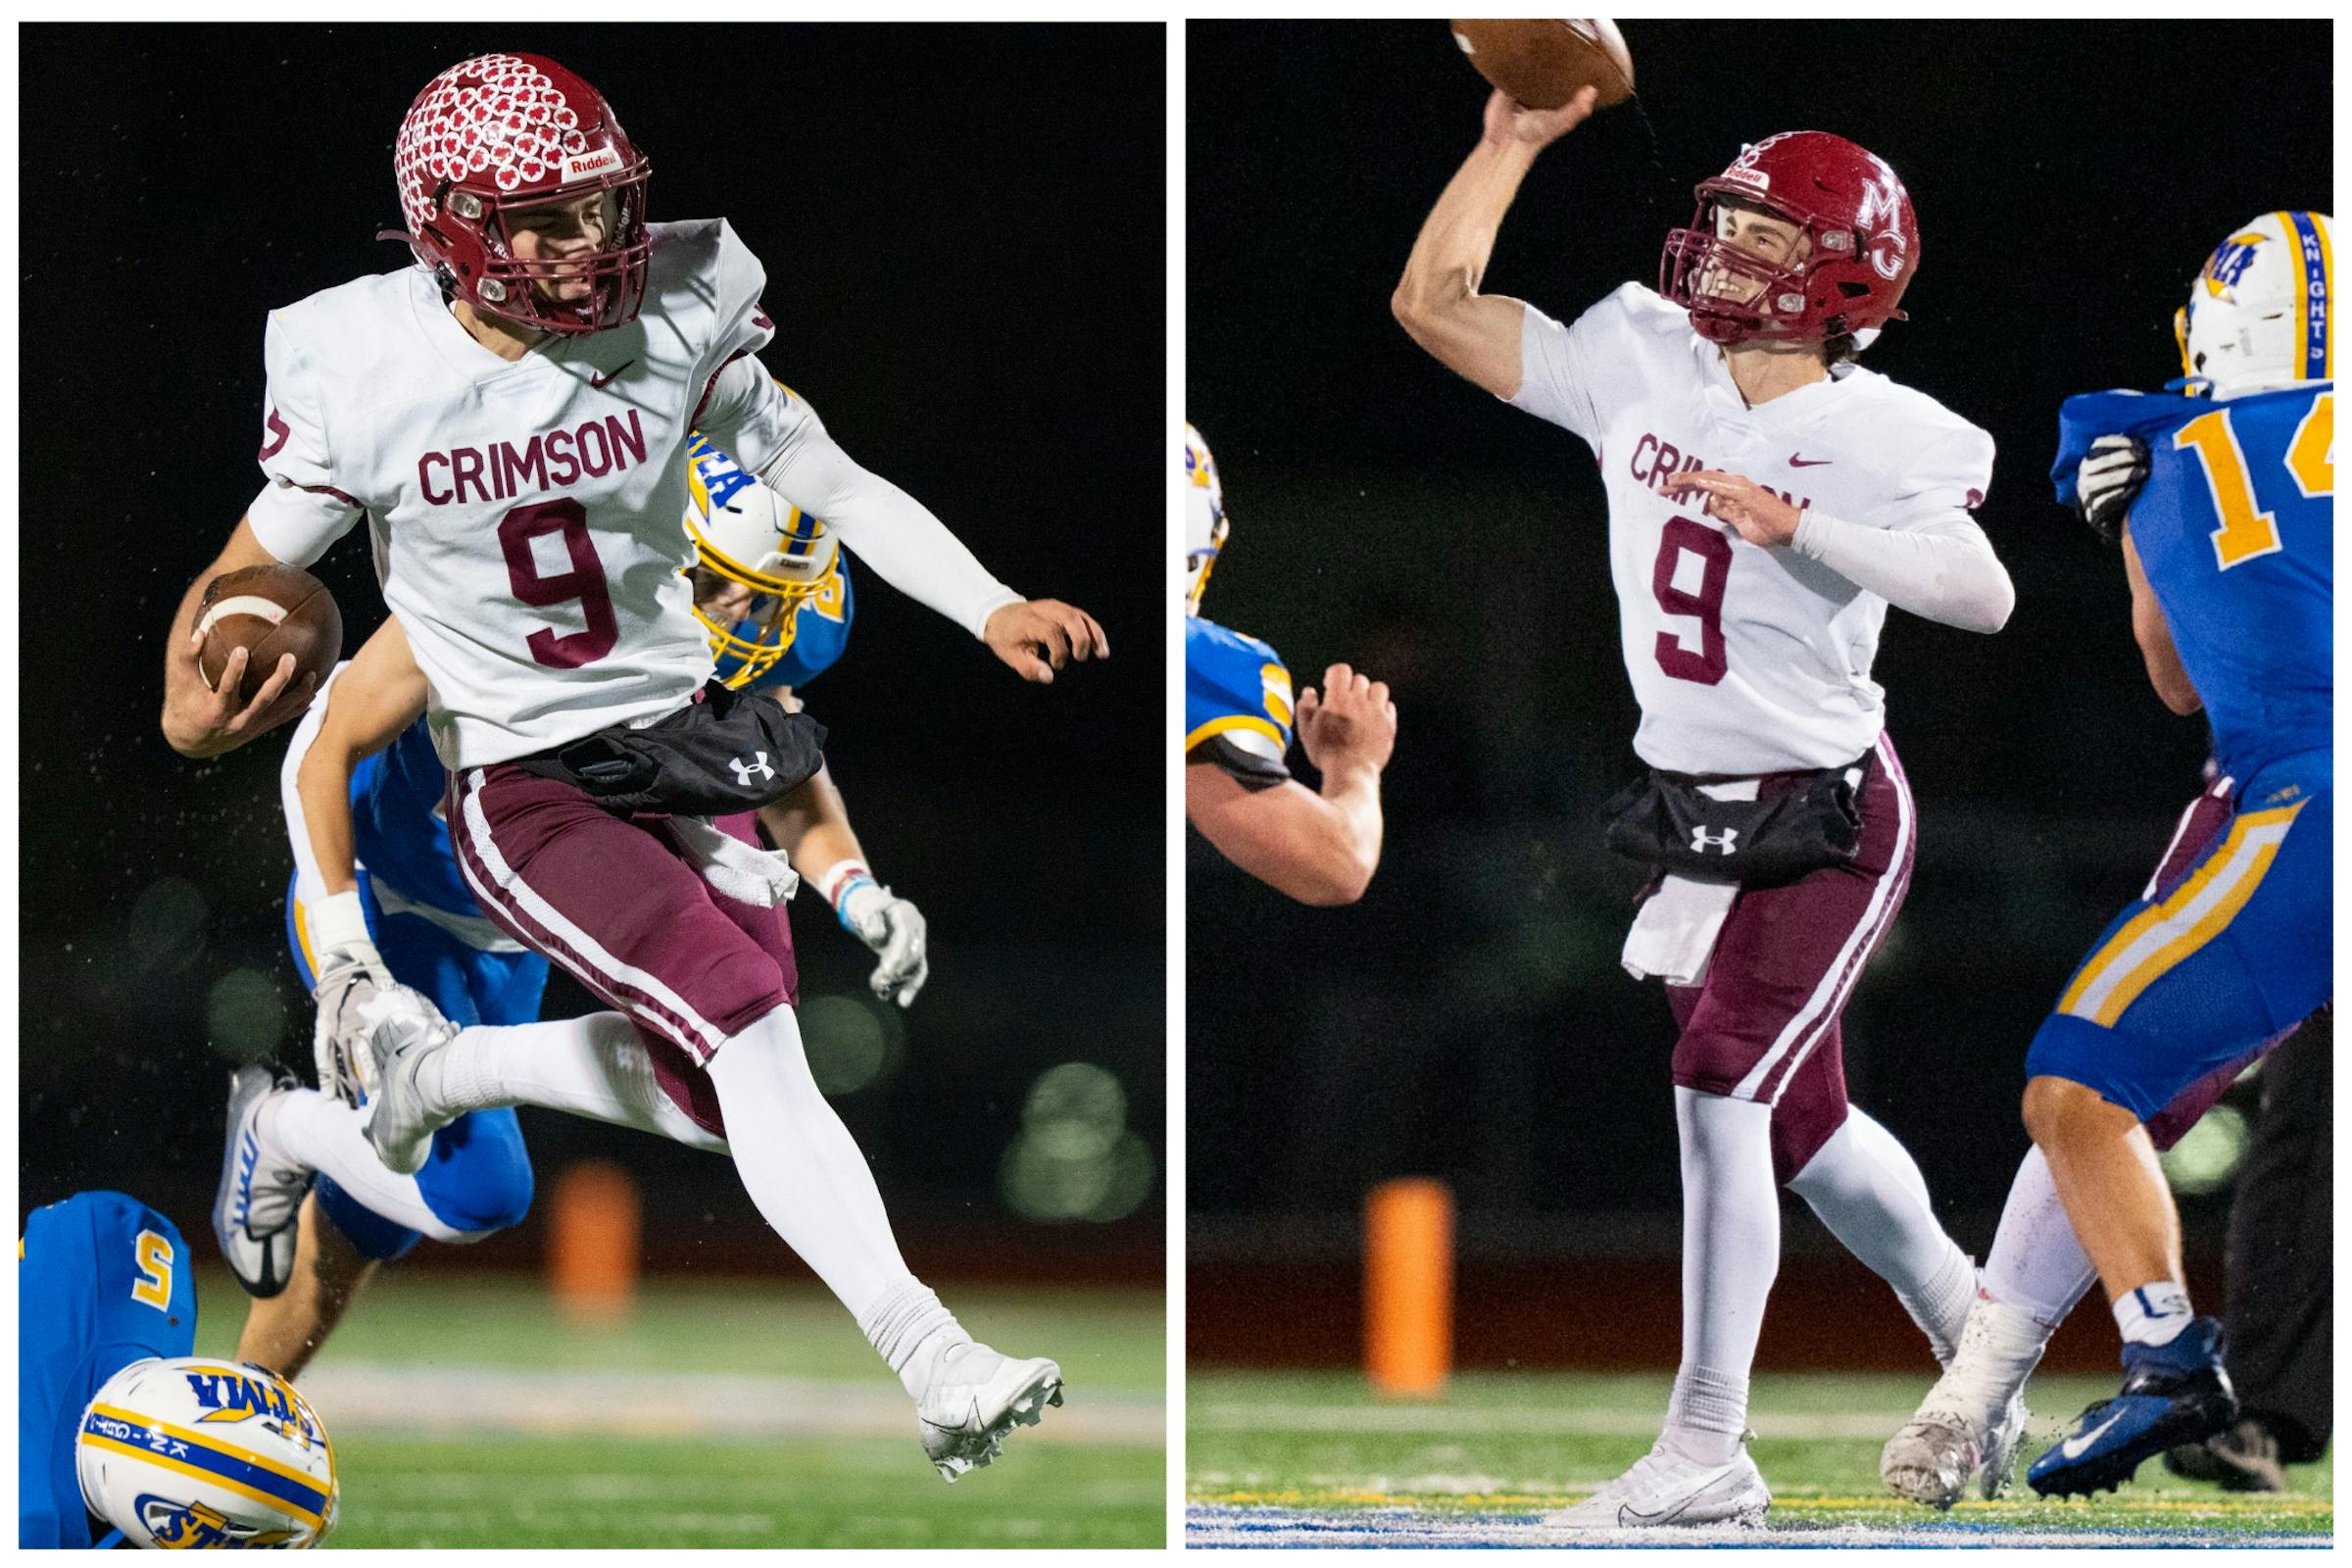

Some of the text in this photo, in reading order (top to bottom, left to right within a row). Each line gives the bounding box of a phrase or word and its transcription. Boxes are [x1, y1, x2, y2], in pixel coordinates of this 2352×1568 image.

[2303, 233, 2326, 360] KNIGHTS
[418, 409, 648, 507] CRIMSON
[1630, 432, 1812, 517] CRIM
[498, 496, 619, 669] 9
[1652, 515, 1734, 687] 9
